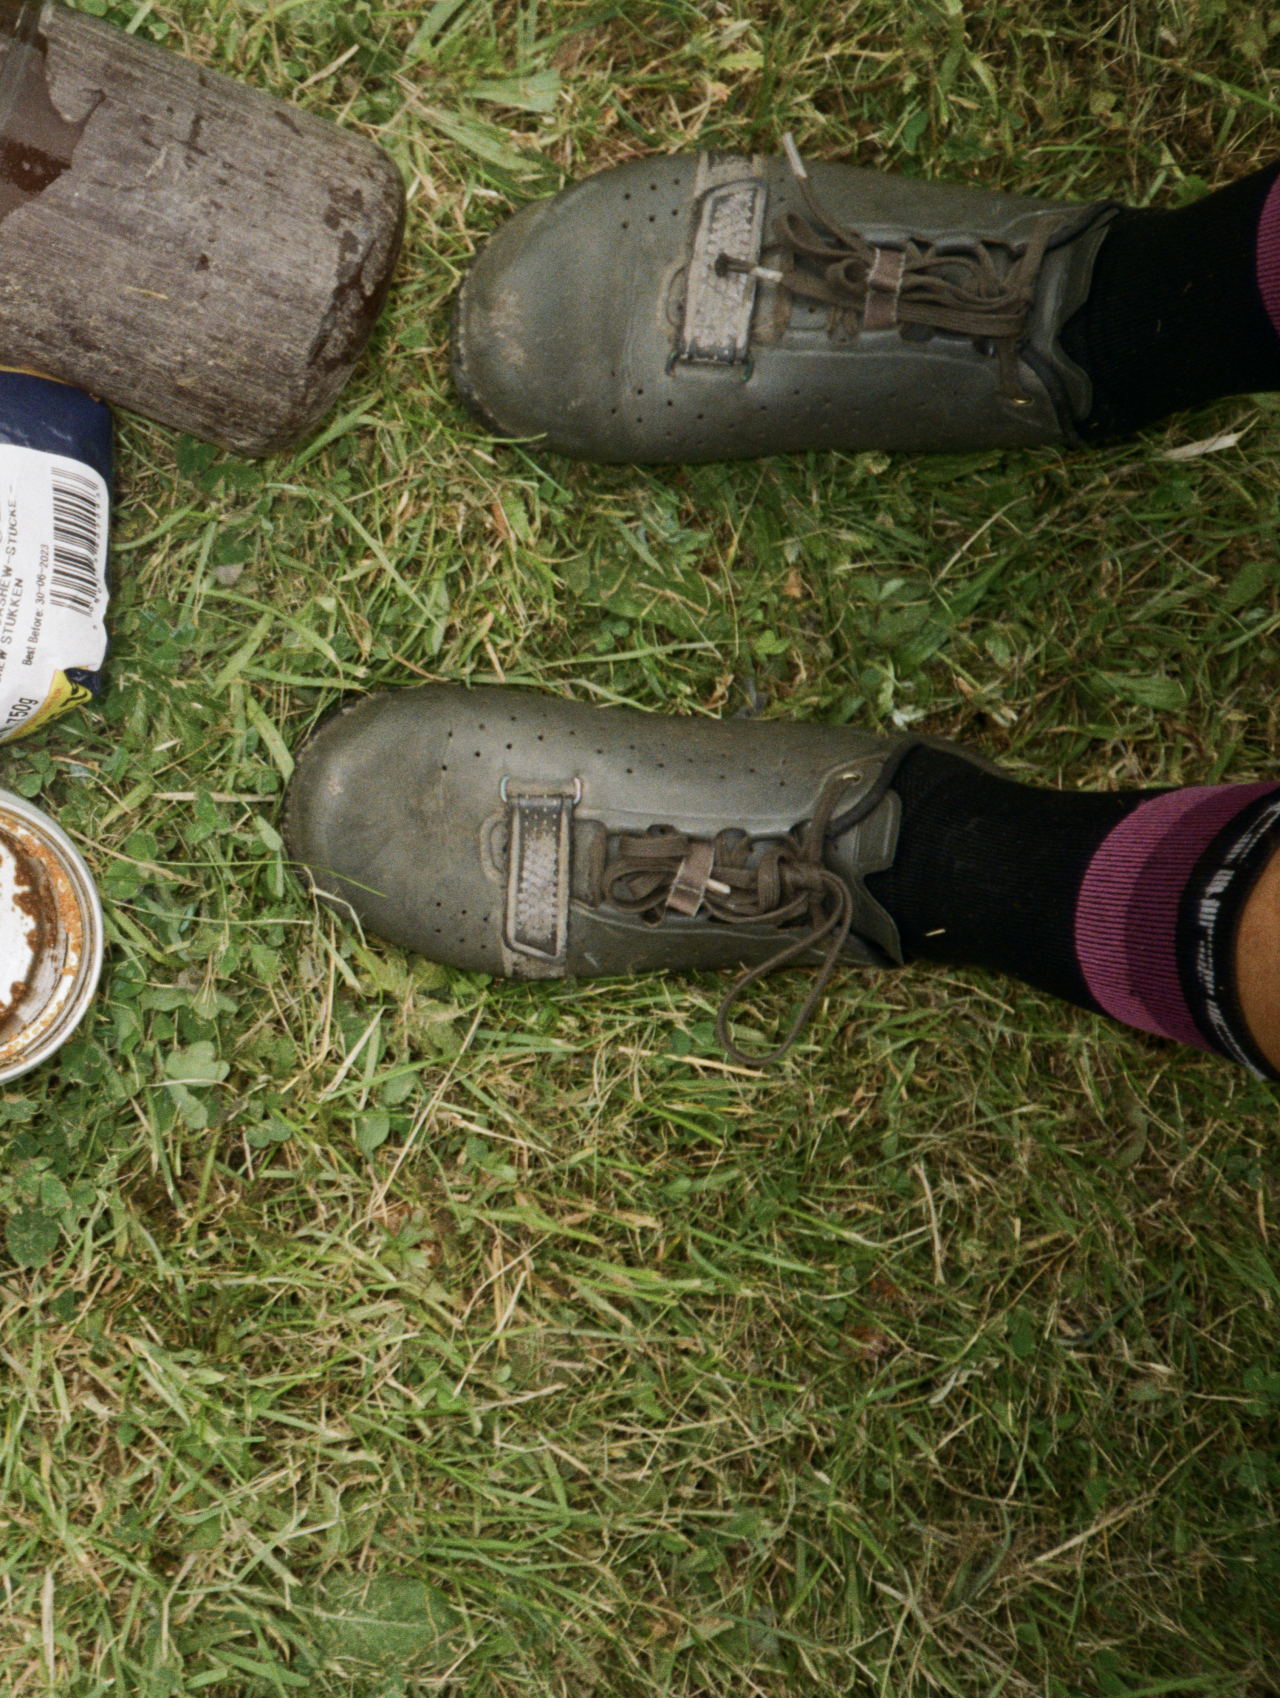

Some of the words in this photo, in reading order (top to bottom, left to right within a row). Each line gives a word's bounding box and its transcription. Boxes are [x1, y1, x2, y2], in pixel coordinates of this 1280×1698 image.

[36, 543, 50, 606] 30-06-2023
[1, 578, 24, 645] STUKKEN
[28, 609, 44, 643] Before:
[22, 643, 35, 666] Best
[6, 697, 39, 726] 750g
